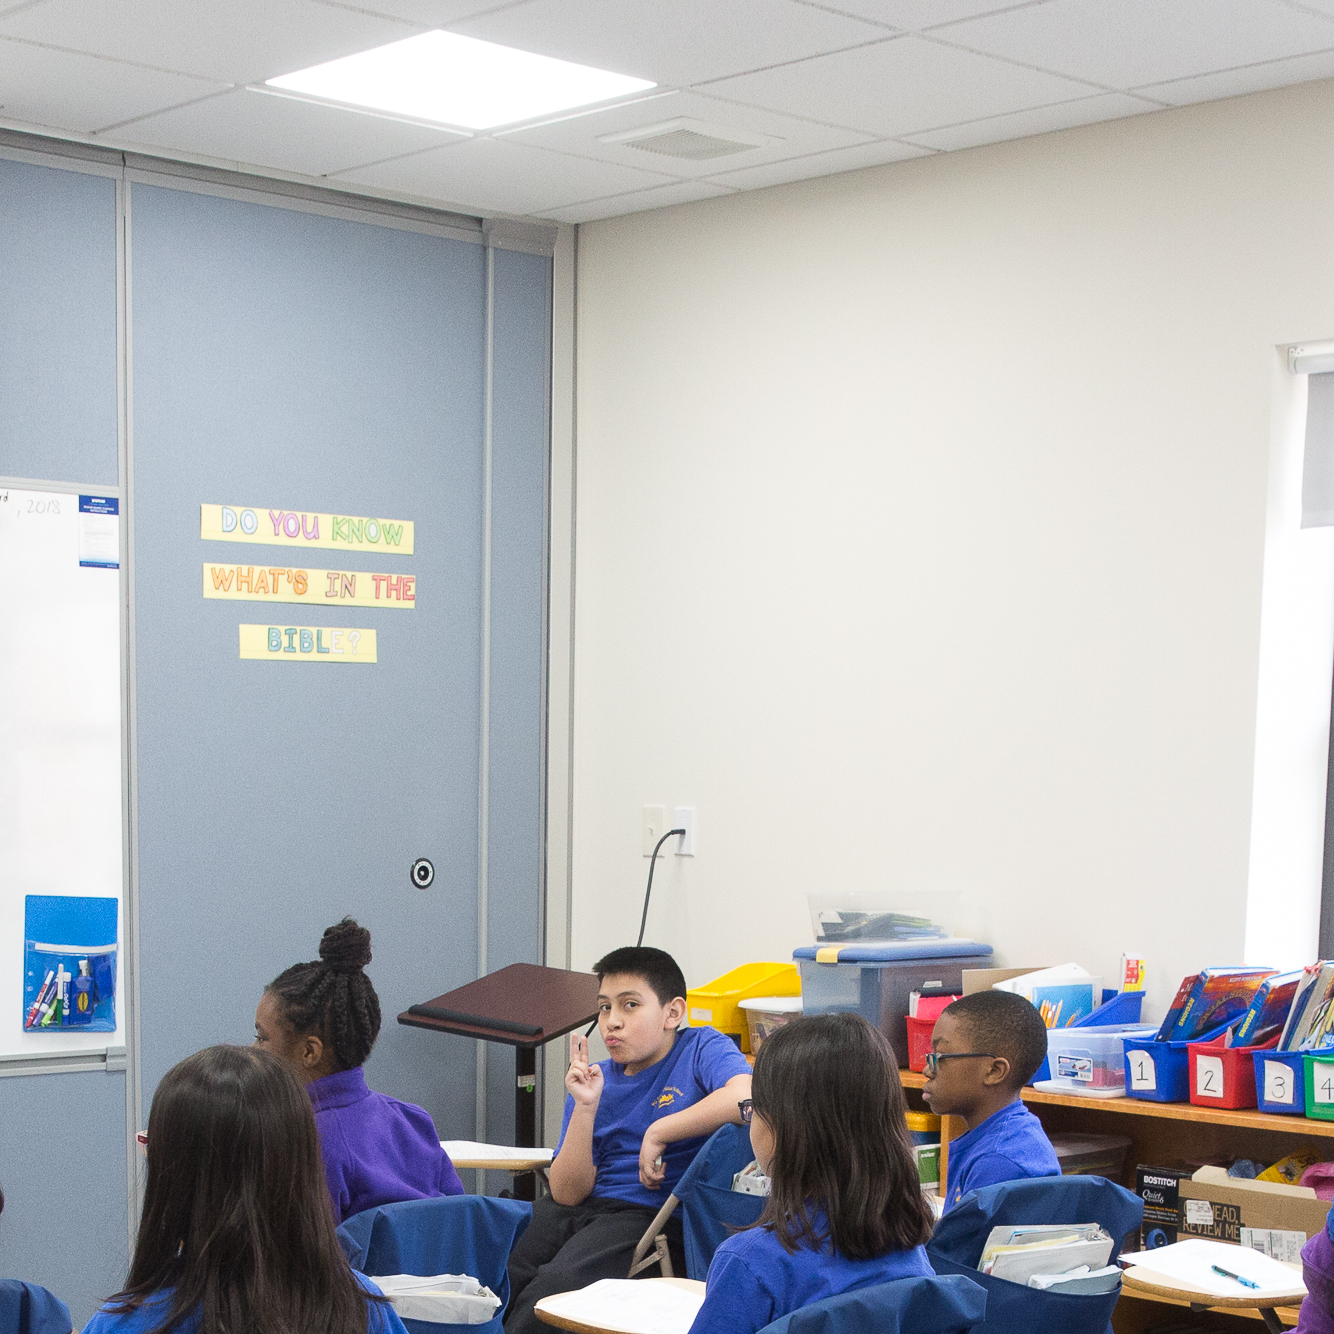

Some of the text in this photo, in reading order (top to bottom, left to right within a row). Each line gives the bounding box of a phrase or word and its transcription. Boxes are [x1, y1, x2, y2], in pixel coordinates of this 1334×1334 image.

[27, 499, 62, 514] 2018
[222, 506, 404, 546] DO YOU KNOW
[210, 566, 416, 601] WHAT'S IN THE
[267, 627, 361, 655] BIBLE?
[1178, 998, 1194, 1027] REGIONS
[1238, 1008, 1256, 1038] REGIONS
[1136, 1061, 1148, 1081] 1
[1203, 1070, 1217, 1092] 2
[1272, 1076, 1286, 1098] 3
[1143, 1175, 1177, 1187] BOSTITCH
[1142, 1189, 1161, 1200] Quiet
[1183, 1216, 1222, 1237] REVIEW
